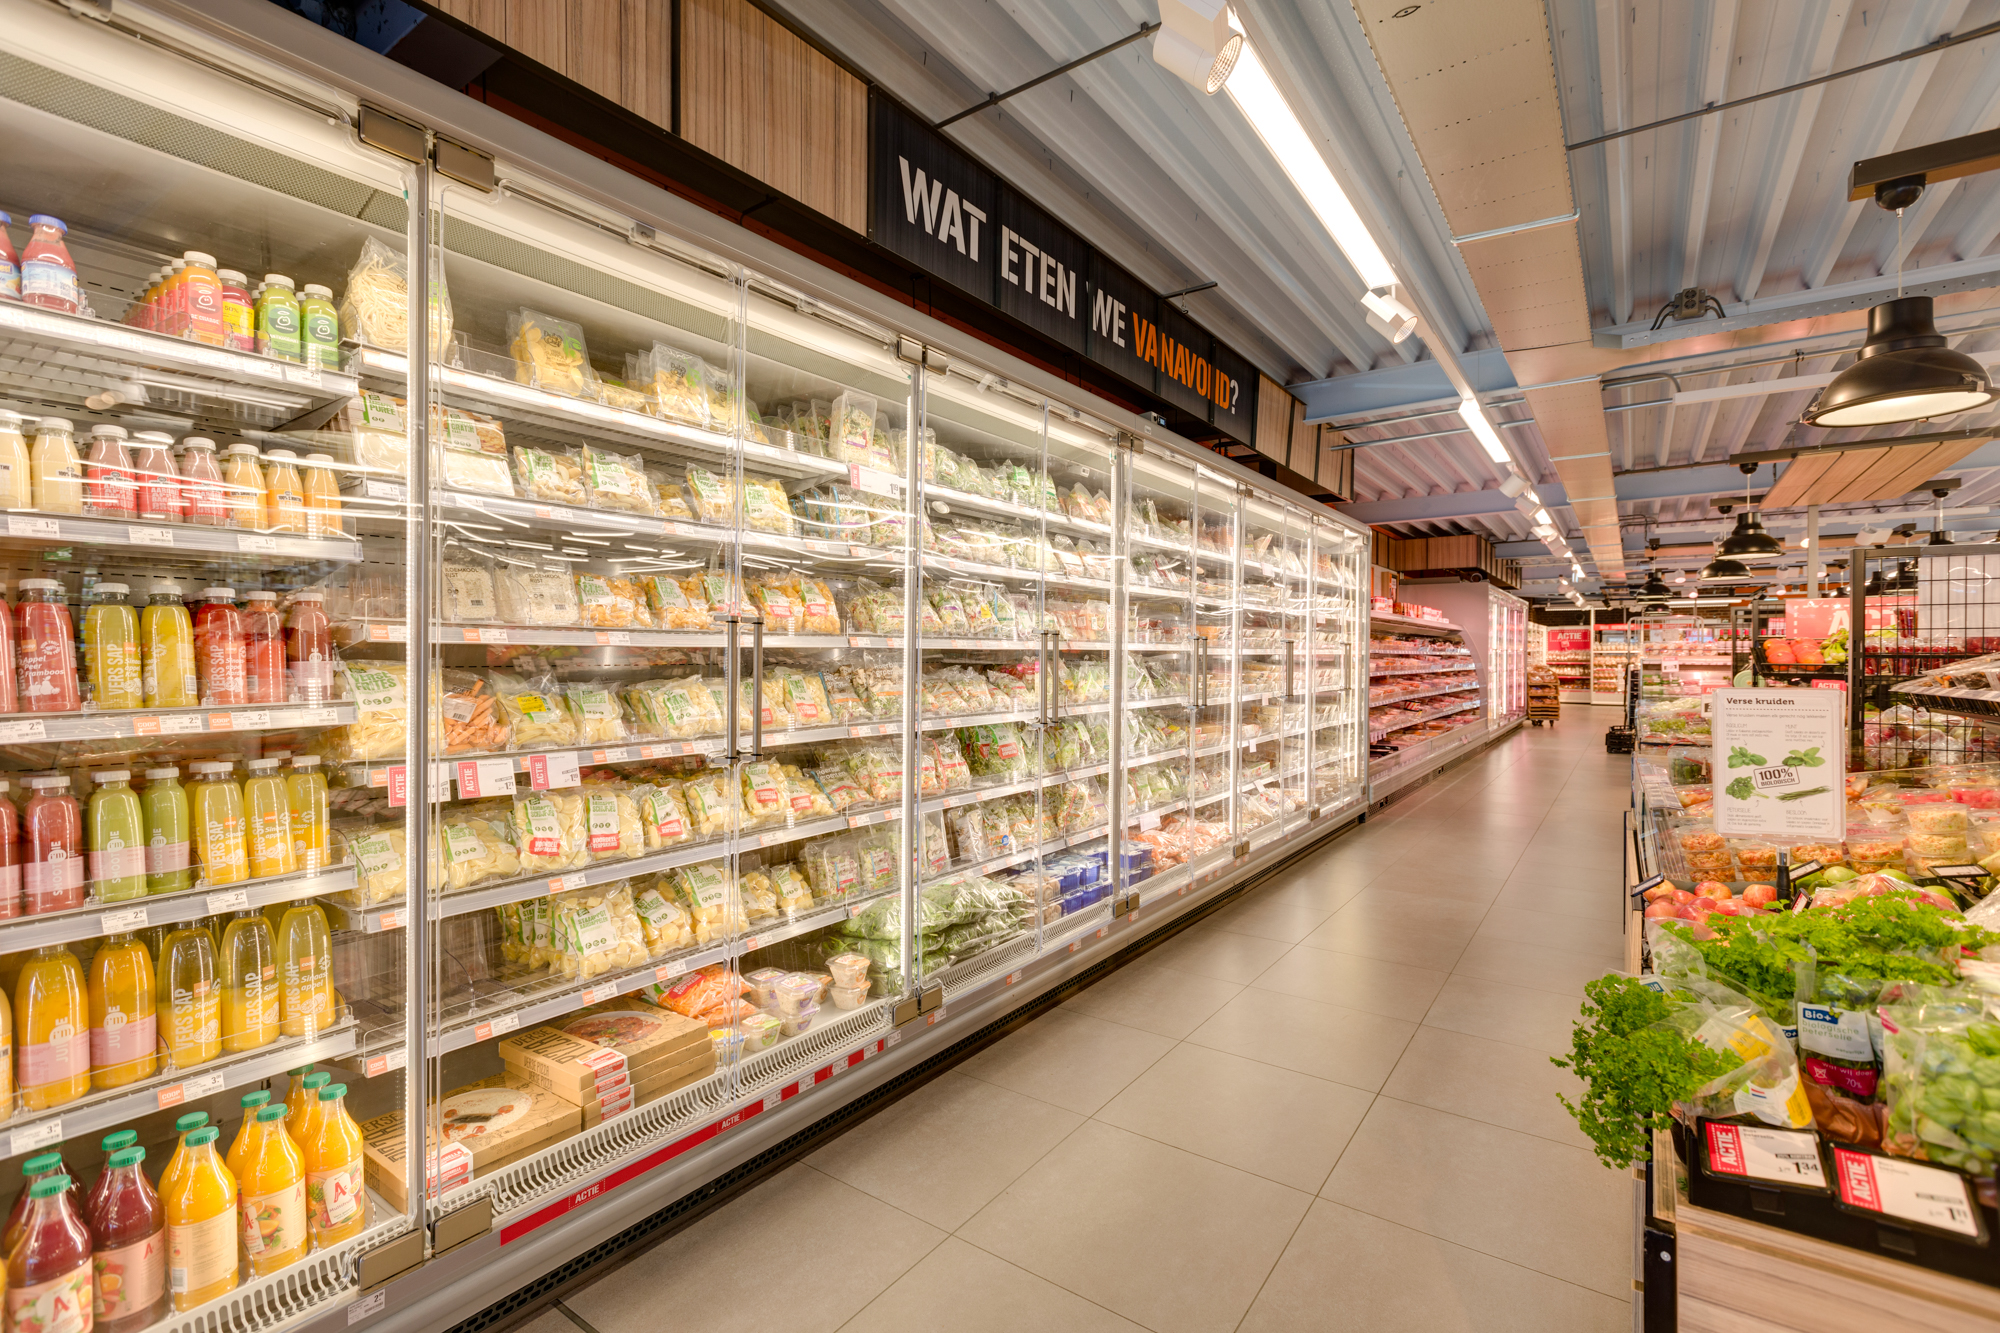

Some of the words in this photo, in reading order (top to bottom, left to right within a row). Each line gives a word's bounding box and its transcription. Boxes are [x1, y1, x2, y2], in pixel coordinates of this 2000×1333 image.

[899, 155, 987, 263] WAT
[1001, 224, 1076, 319] ETEN
[1086, 281, 1126, 348] WE
[1557, 632, 1582, 640] ACTIE
[23, 655, 46, 663] Appel
[107, 643, 124, 665] SAP
[210, 645, 225, 666] SAP
[25, 669, 65, 677] Framboos
[107, 667, 125, 696] VERS
[211, 668, 226, 693] VERS
[350, 671, 392, 682] VERSE
[355, 678, 397, 691] FRITES
[1817, 682, 1841, 690] ACTIE
[465, 768, 475, 792] ACTIE
[535, 761, 545, 784] ACTIE
[1759, 767, 1793, 781] 100%
[395, 773, 405, 799] ACTIE
[209, 820, 224, 841] SAP
[252, 816, 264, 835] SAP
[211, 838, 227, 870] VERS
[254, 836, 267, 863] VERS
[245, 972, 262, 997] SAP
[285, 962, 300, 986] SAP
[301, 979, 324, 991] appel
[175, 988, 193, 1014] SAP
[286, 987, 301, 1019] VERS
[106, 1014, 124, 1025] i'm
[246, 997, 263, 1033] VERS
[1804, 1010, 1832, 1021] Bio+
[53, 1027, 71, 1039] i'm
[175, 1012, 194, 1051] VERS
[477, 1027, 490, 1035] COOP
[510, 1028, 553, 1046] VERSE
[1802, 1020, 1860, 1034] biologische
[1802, 1026, 1852, 1041] peterselie
[370, 1060, 385, 1069] COOP
[524, 1056, 536, 1071] VERSE
[537, 1060, 549, 1077] PIZZA
[161, 1088, 181, 1100] COOP
[361, 1112, 403, 1135] ERSE
[721, 1113, 741, 1130] ACTIE
[1716, 1130, 1738, 1166] ACTIE
[1847, 1160, 1872, 1201] ACTIE
[575, 1184, 600, 1204] ACTIE
